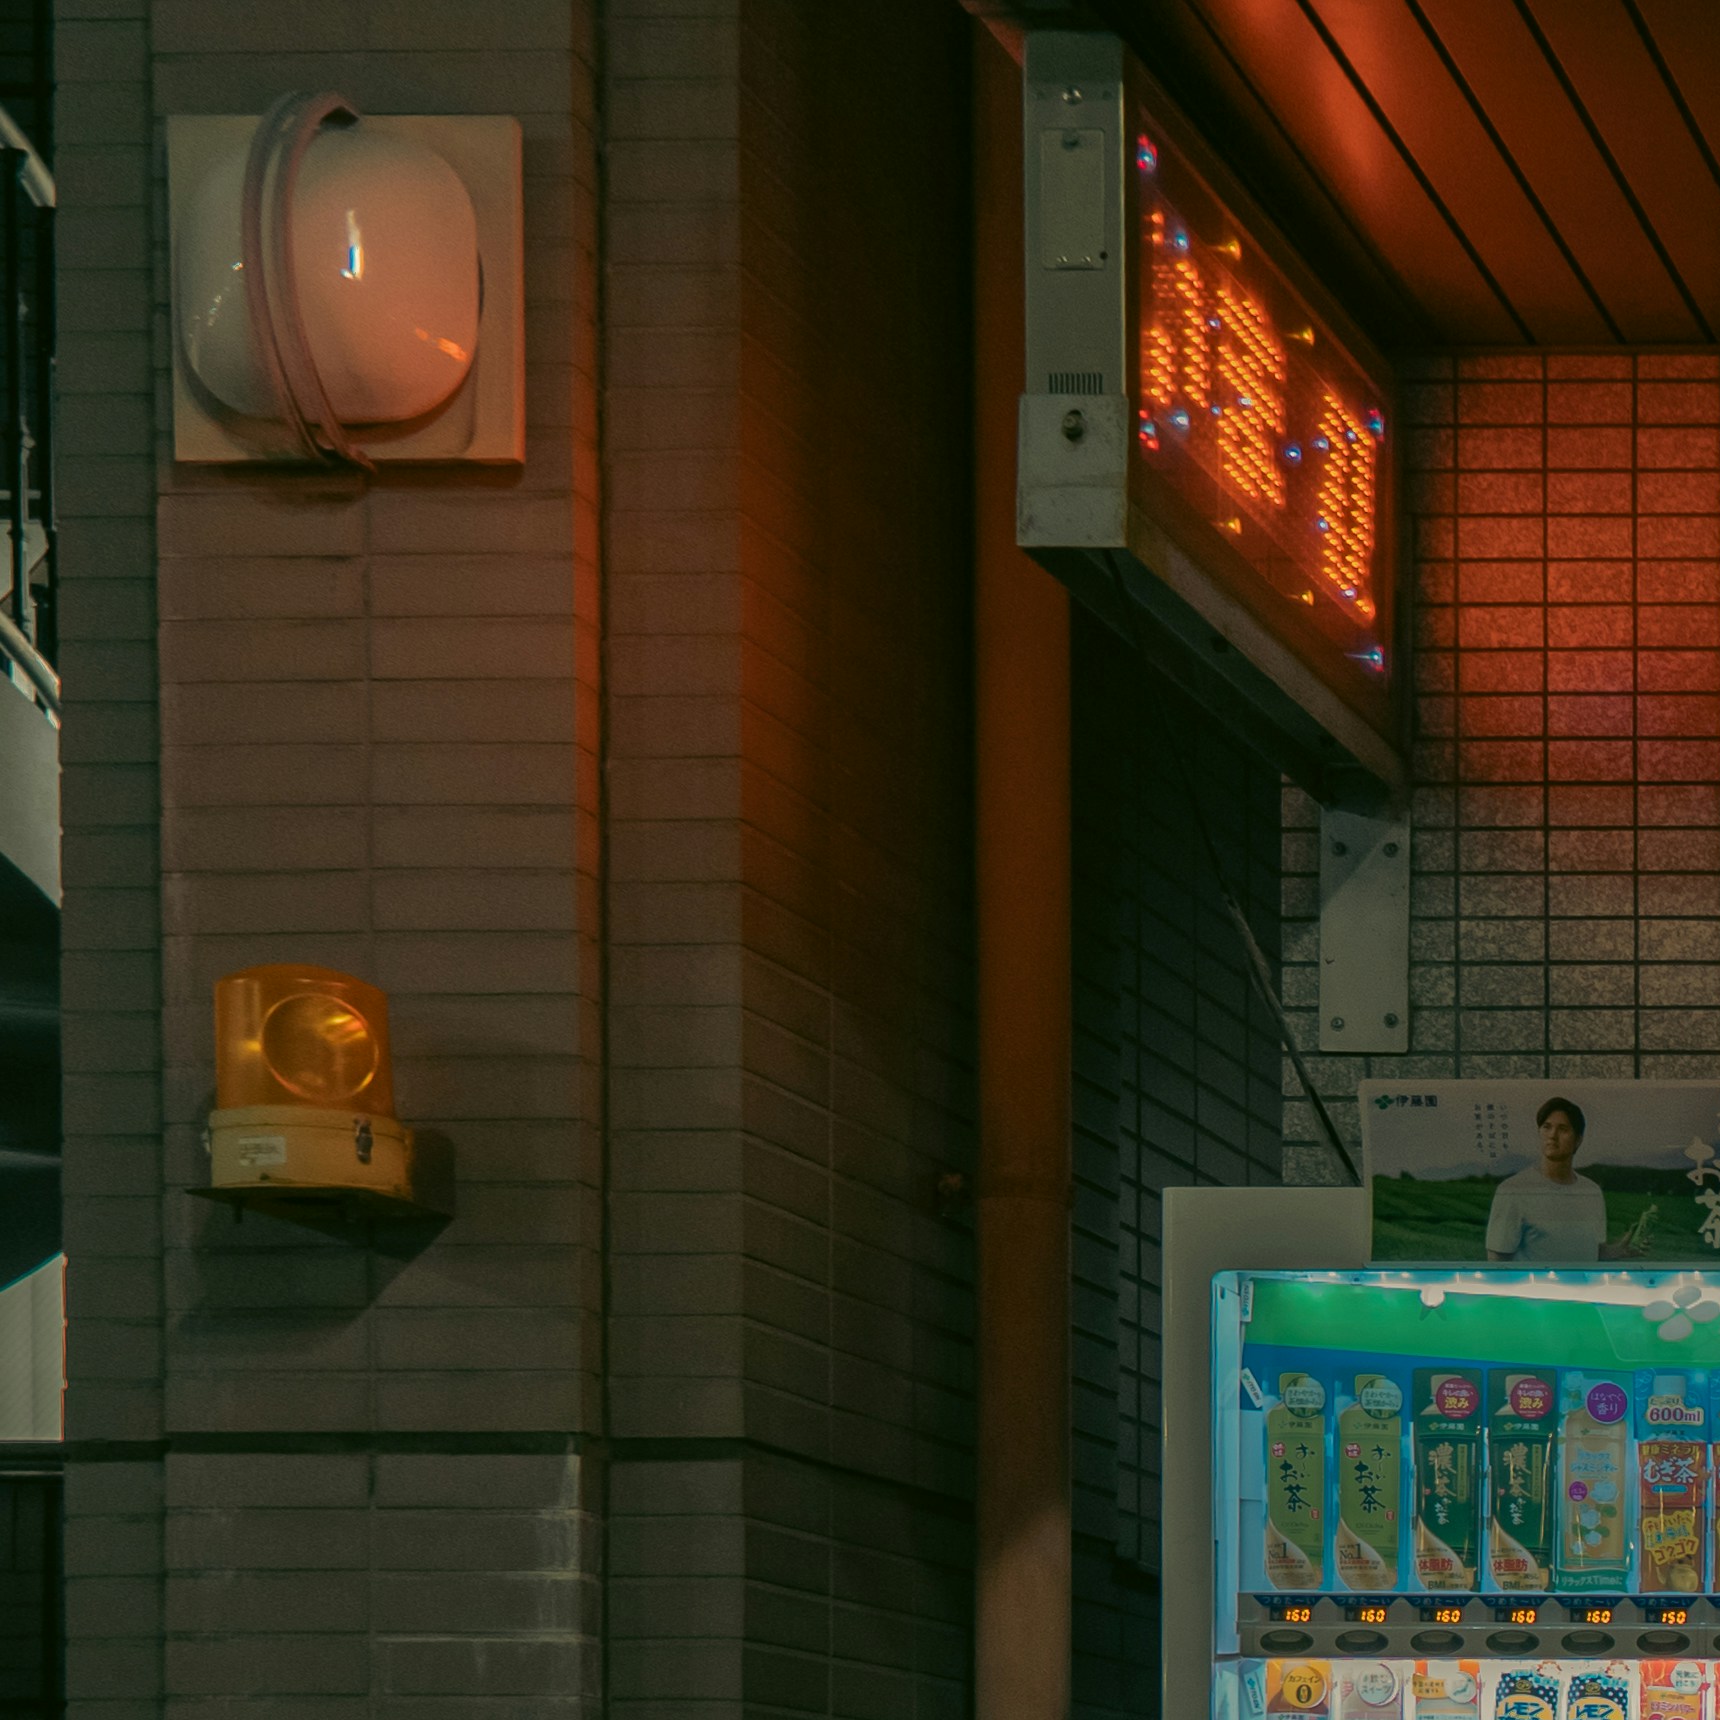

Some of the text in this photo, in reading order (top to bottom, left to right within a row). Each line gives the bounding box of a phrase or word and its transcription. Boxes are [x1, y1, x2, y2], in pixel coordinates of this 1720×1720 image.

[1445, 1397, 1469, 1409] 渋み
[1596, 1402, 1618, 1415] 香り
[1649, 1406, 1701, 1422] 600ml
[1643, 1457, 1699, 1484] むぎ茶
[1279, 1459, 1311, 1513] お茶
[1354, 1460, 1386, 1514] お茶
[1655, 1537, 1697, 1562] ゴクゴク
[1418, 1557, 1454, 1573] 体脂肪
[1493, 1557, 1528, 1573] 体脂肪
[1285, 1609, 1311, 1622] 160
[1361, 1609, 1386, 1622] 160
[1436, 1609, 1461, 1623] 160
[1511, 1609, 1536, 1623] 160
[1661, 1610, 1687, 1624] 150
[1287, 1674, 1321, 1684] カフェイン
[1296, 1684, 1313, 1704] 0
[1503, 1701, 1544, 1716] レモン
[1575, 1703, 1616, 1717] レモン
